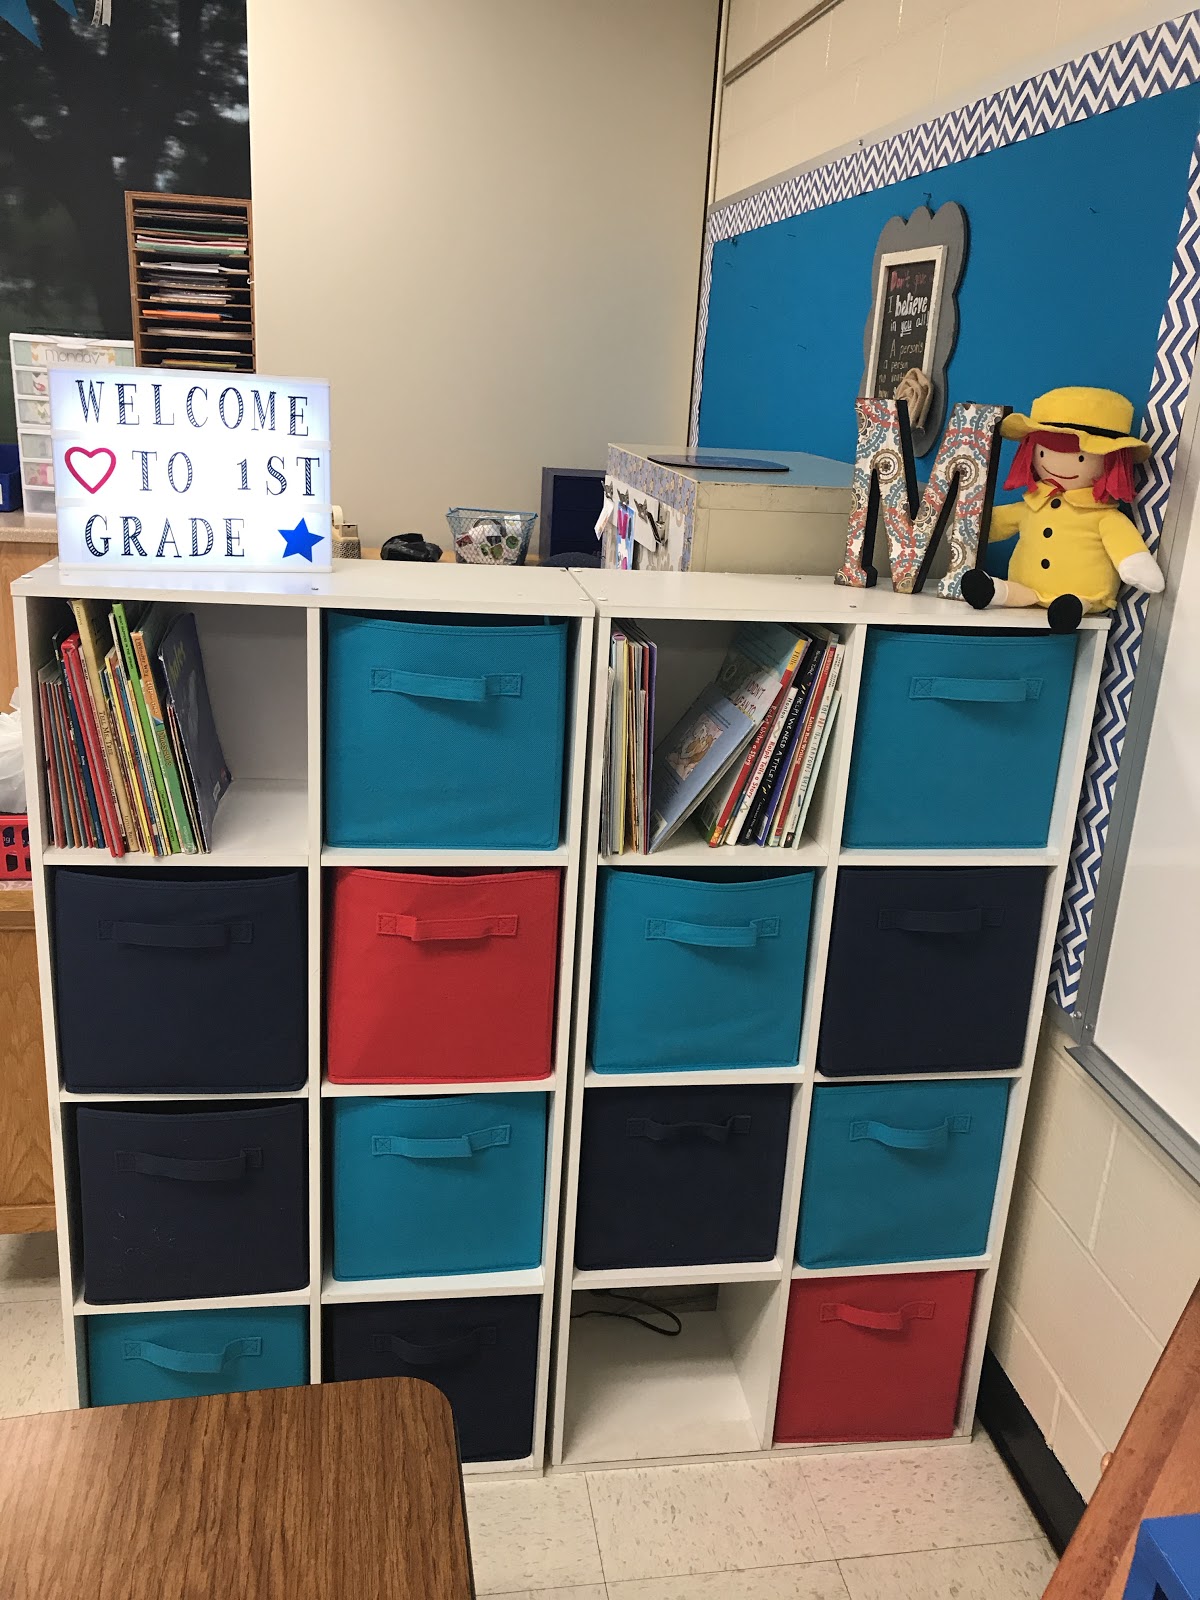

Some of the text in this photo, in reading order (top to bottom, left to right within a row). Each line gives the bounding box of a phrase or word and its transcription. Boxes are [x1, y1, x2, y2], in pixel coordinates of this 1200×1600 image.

[888, 292, 928, 317] I believe
[890, 318, 897, 332] in
[900, 320, 912, 337] you
[889, 339, 924, 359] A person's
[890, 360, 909, 373] person
[75, 379, 309, 437] WELCOME
[132, 450, 321, 496] TO 1ST
[84, 514, 246, 558] GRADE
[792, 696, 804, 716] HELP!
[98, 710, 107, 725] TELL
[105, 740, 114, 755] TREE
[785, 717, 796, 730] WE
[806, 715, 814, 731] Little
[755, 726, 767, 743] Writes
[779, 730, 790, 749] NEED
[157, 730, 172, 767] Dinosaurs
[763, 741, 776, 764] Ralph
[745, 750, 757, 767] Story
[757, 761, 768, 775] Tells
[746, 781, 759, 798] Story
